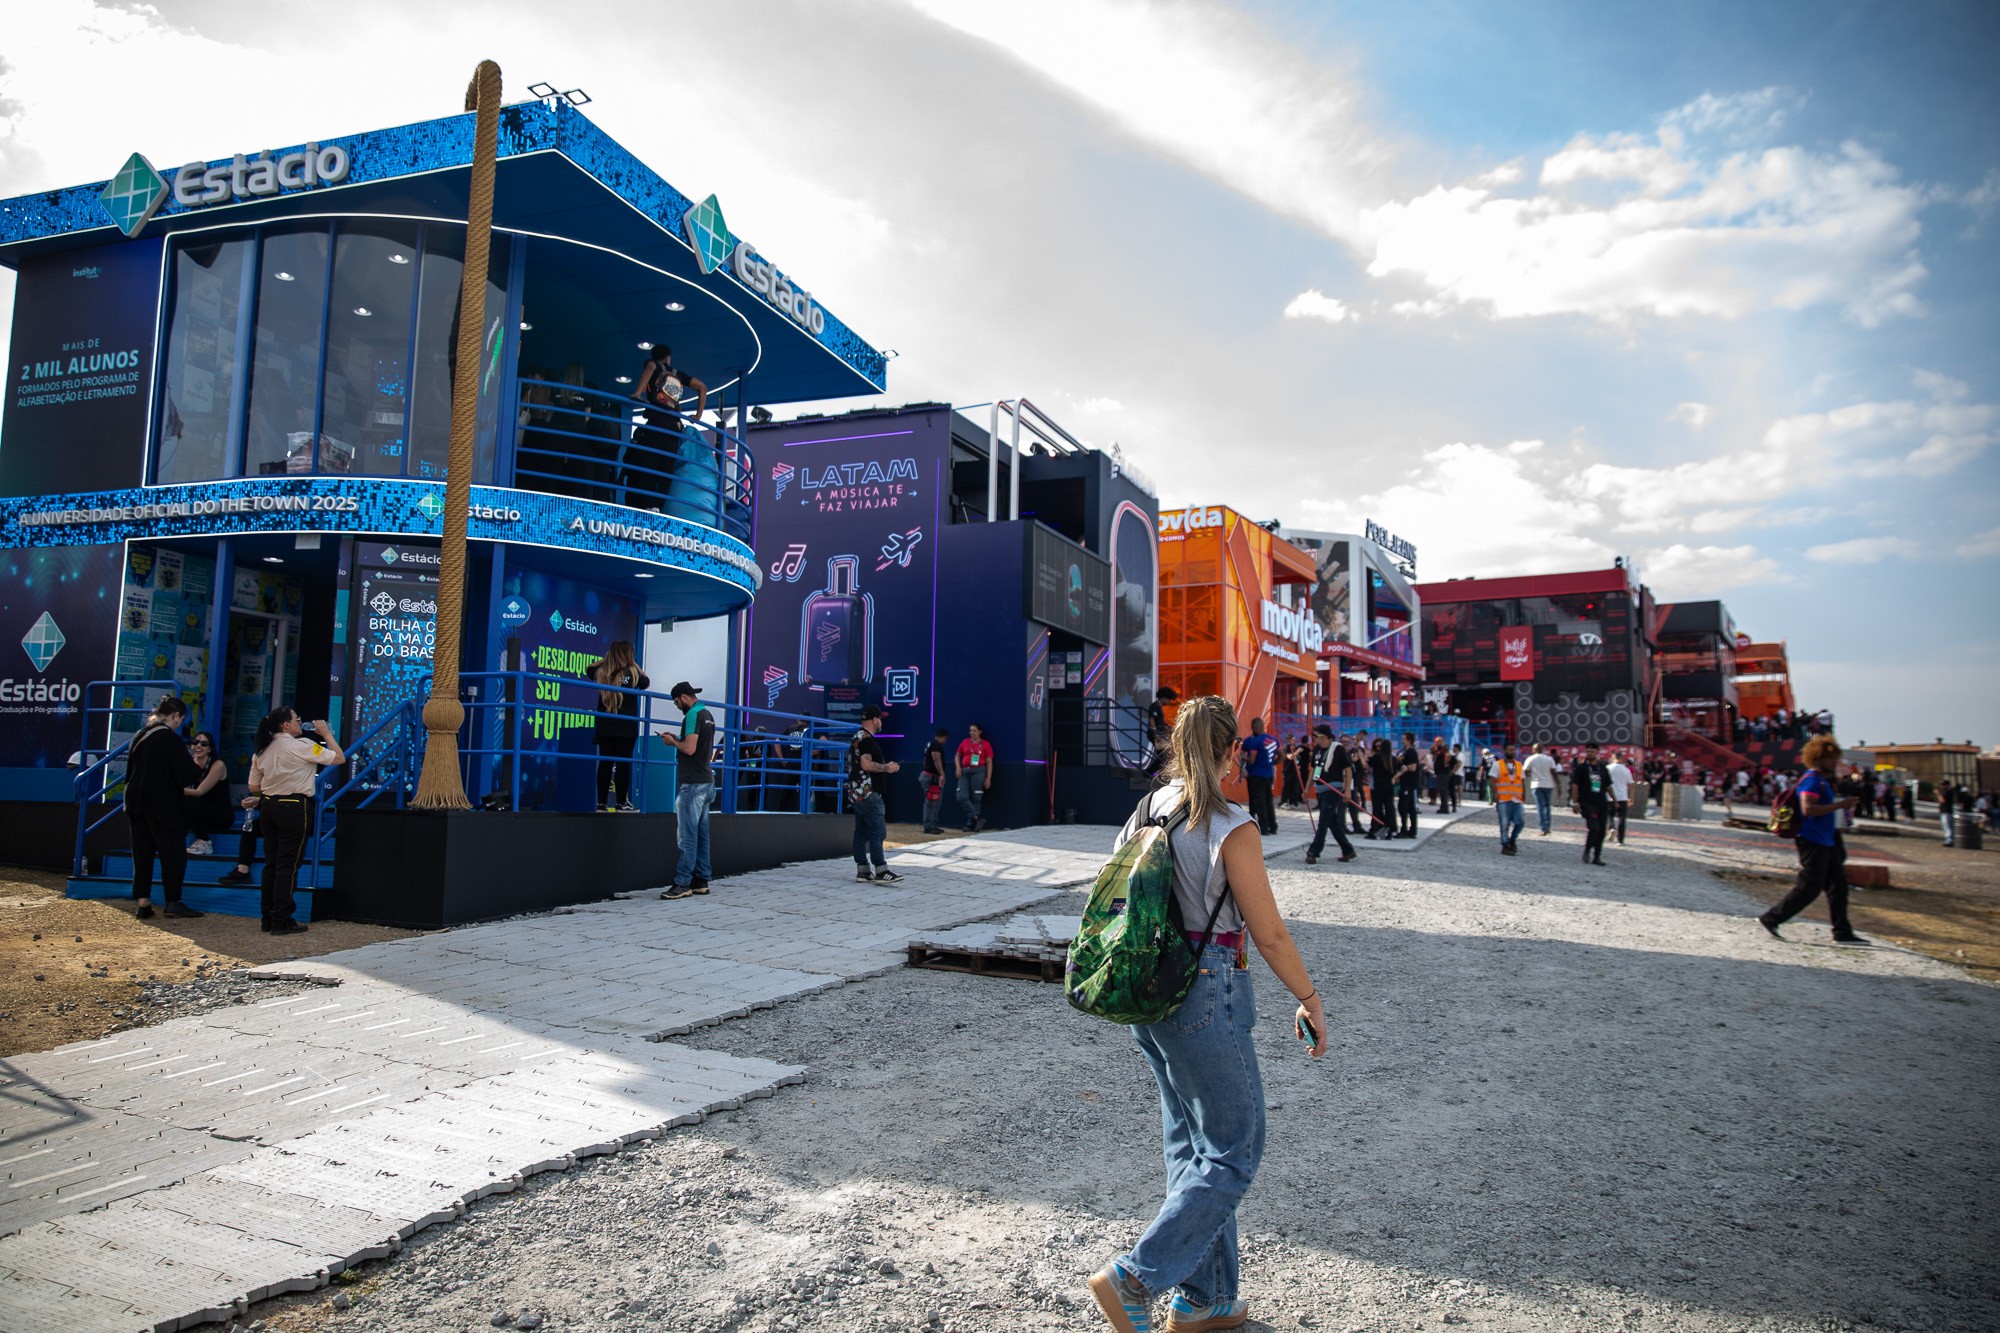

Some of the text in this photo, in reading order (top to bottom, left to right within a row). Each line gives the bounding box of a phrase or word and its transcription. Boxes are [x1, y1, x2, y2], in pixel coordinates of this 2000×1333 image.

[174, 142, 349, 206] Estácio
[735, 242, 824, 335] Estácio
[63, 338, 100, 350] MAIS DE
[22, 350, 139, 380] 2 MIL ALUNOS
[18, 372, 139, 394] FORMADOS PELO PROGRAMA DE
[18, 385, 137, 407] ALFABETIZAÇÃO E LETRAMENTO
[801, 458, 918, 489] LATAM
[816, 484, 903, 500] A MÚSICA TE
[20, 496, 358, 526] A UNIVERSIDADE OFICIAL DO THE TOWN 2025
[468, 504, 520, 520] stácio
[820, 498, 898, 512] FAZ VIAJAR
[1159, 504, 1223, 533] ovida
[570, 517, 584, 531] A
[588, 520, 701, 552] UNIVERSIDADE
[704, 543, 738, 564] OFICIAL
[399, 599, 438, 614] Está
[370, 618, 421, 631] BRILHA
[565, 618, 597, 635] Estácio
[1260, 597, 1323, 654] movida
[383, 632, 393, 643] A
[374, 645, 435, 658] DO BRAS
[538, 646, 603, 678] DESBLOQU
[0, 678, 80, 701] Estácio
[536, 672, 560, 701] SEU
[0, 706, 28, 714] Graduação
[35, 706, 78, 714] Pós-graduação
